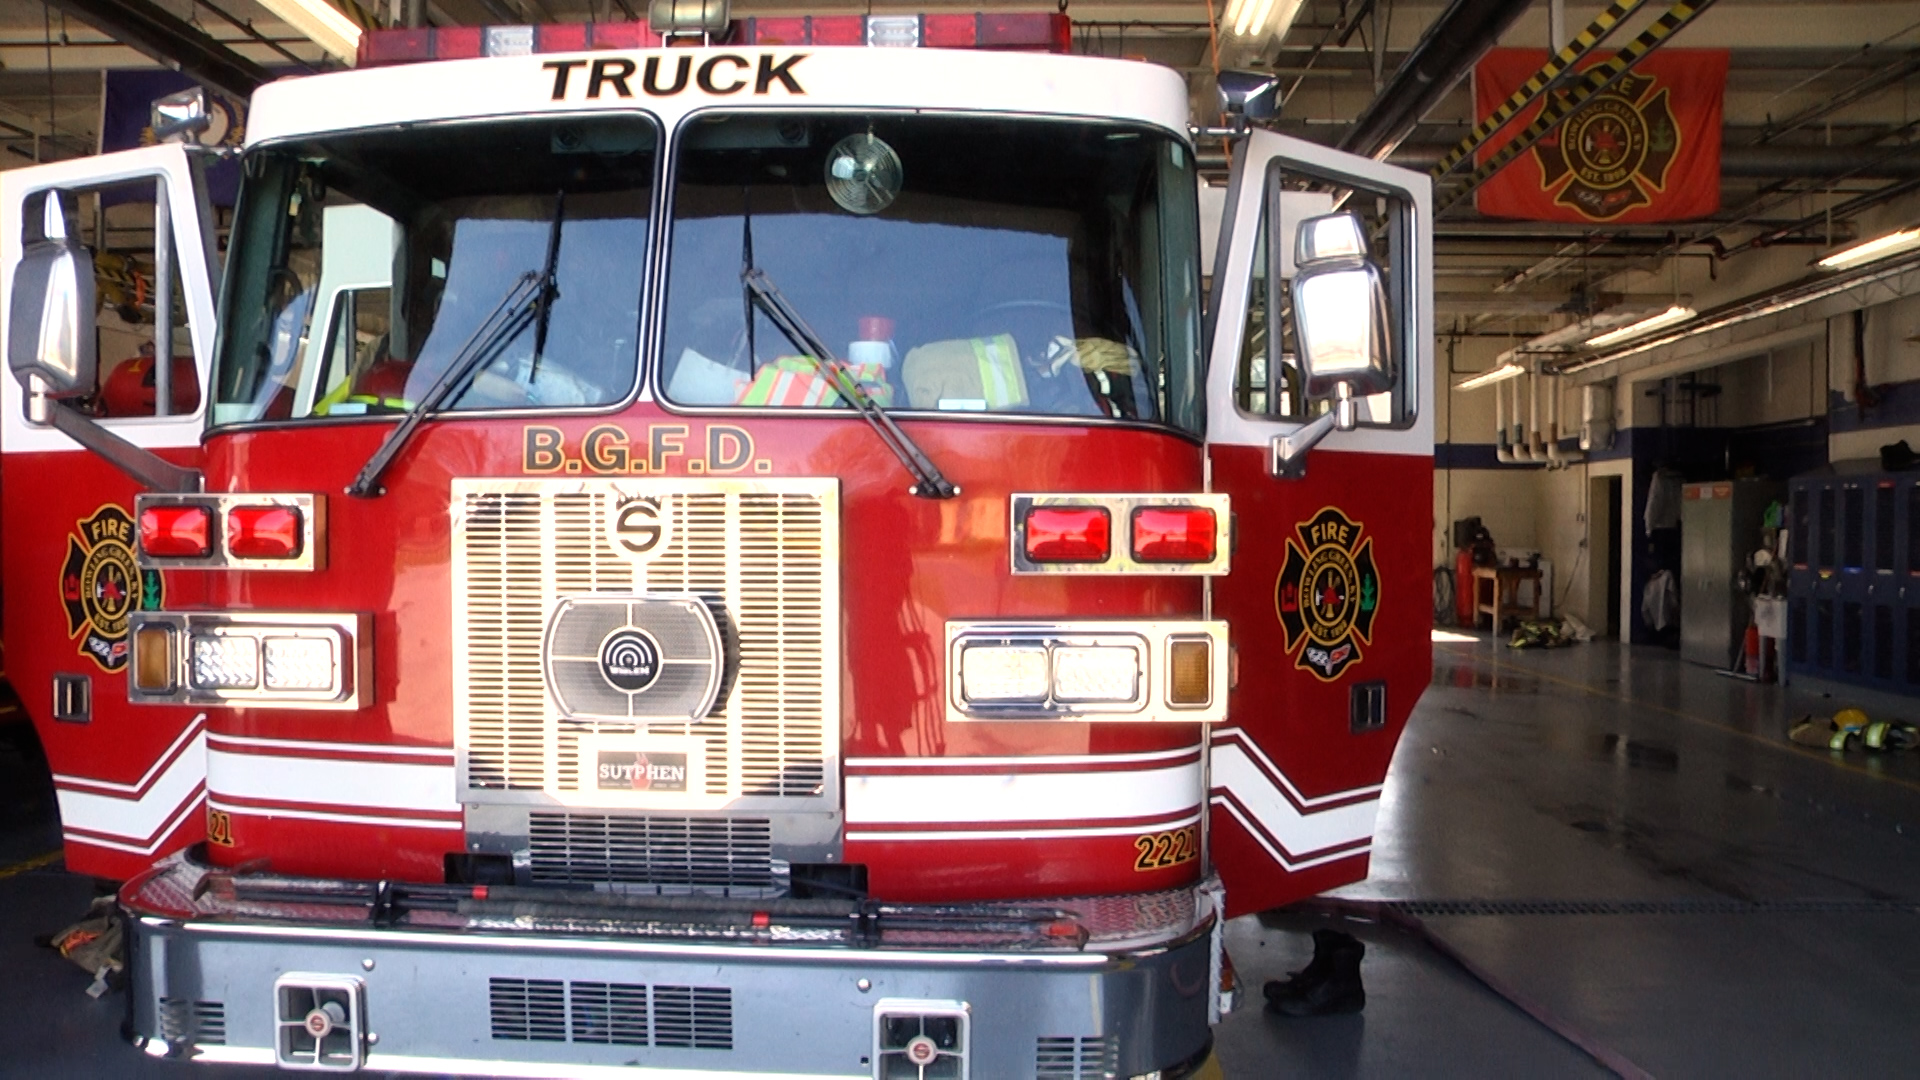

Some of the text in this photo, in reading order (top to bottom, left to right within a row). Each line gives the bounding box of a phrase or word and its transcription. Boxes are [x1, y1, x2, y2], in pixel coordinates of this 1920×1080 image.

[542, 53, 813, 101] TRUCK
[522, 423, 773, 474] B.G.F.D.
[91, 517, 131, 542] FIRE
[616, 504, 662, 552] S
[1310, 520, 1351, 546] FIRE
[598, 762, 685, 782] SUTPHEN
[1134, 826, 1198, 873] 2221
